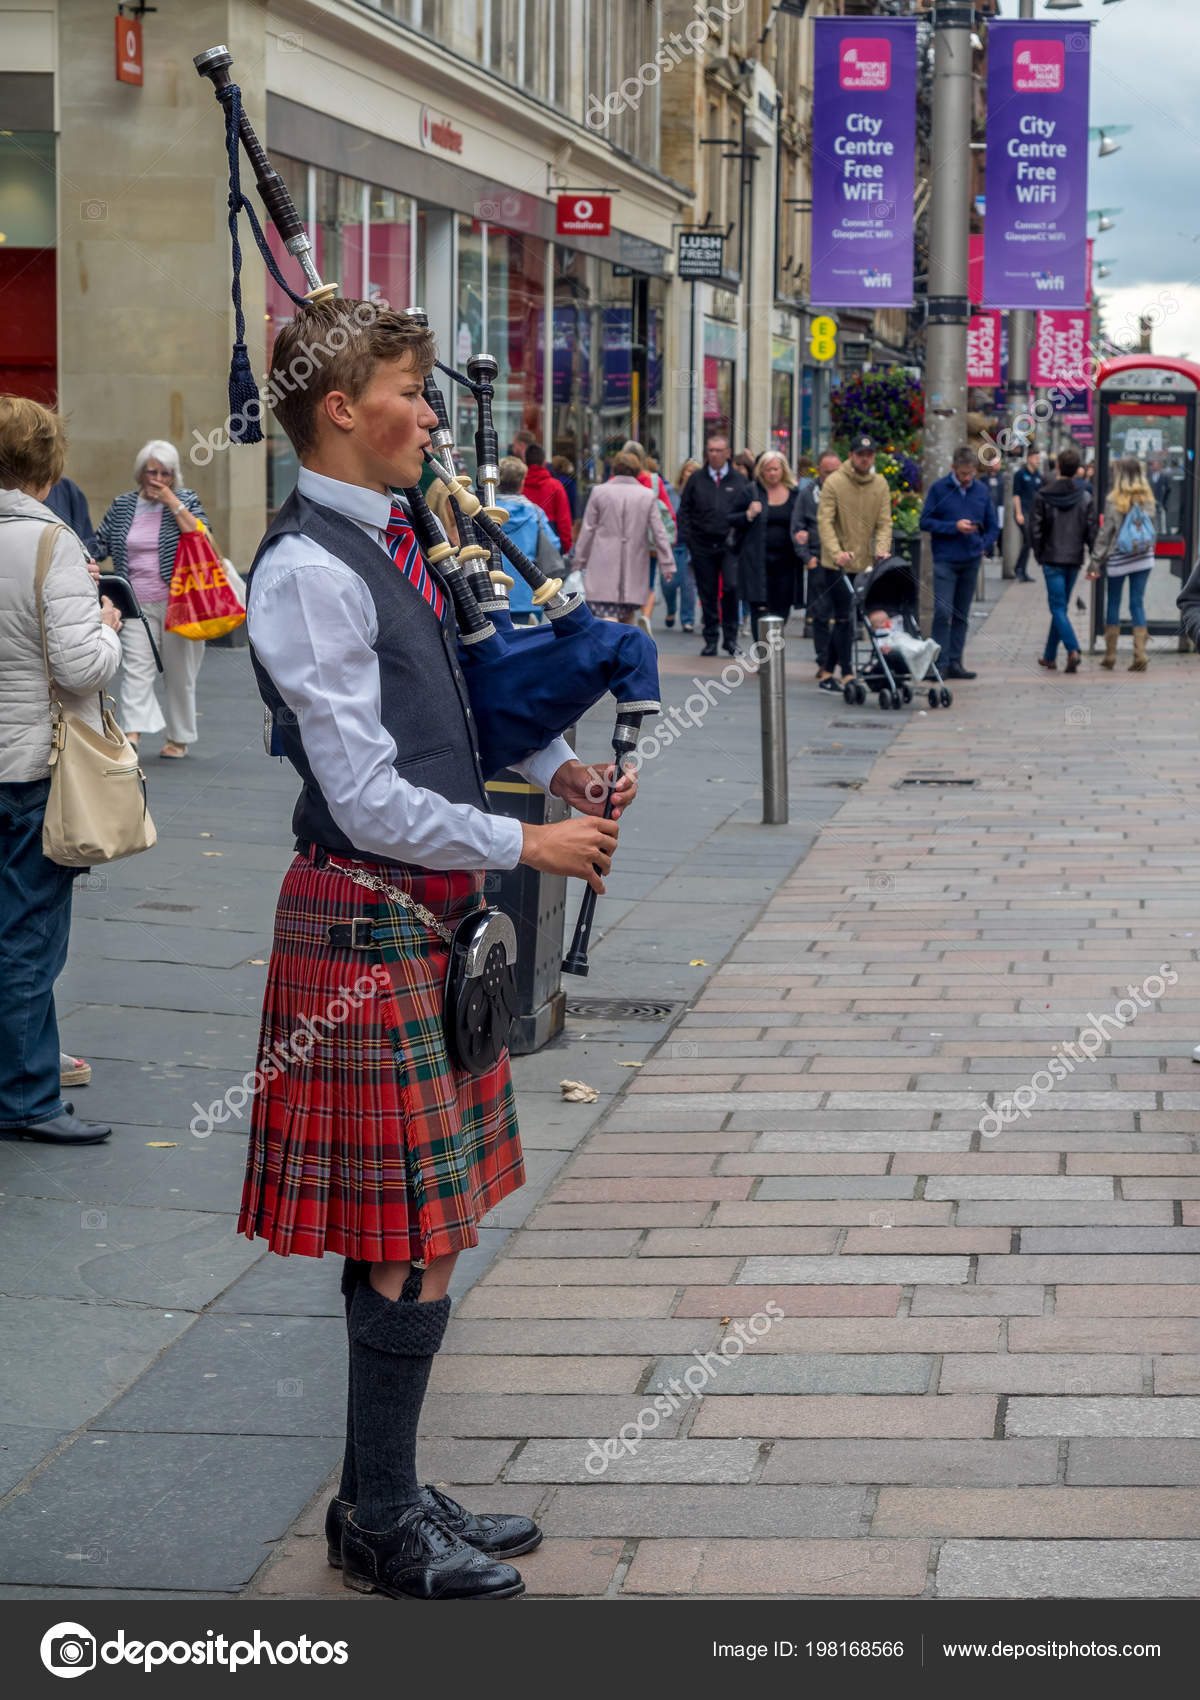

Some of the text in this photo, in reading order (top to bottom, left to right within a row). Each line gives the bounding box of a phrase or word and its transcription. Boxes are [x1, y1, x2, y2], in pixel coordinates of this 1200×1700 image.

[846, 112, 883, 136] City
[1019, 115, 1056, 138] City
[834, 136, 894, 155] Centre
[1007, 138, 1067, 158] Centre
[844, 159, 884, 178] Free
[1017, 161, 1056, 181] Free
[843, 182, 883, 201] WiFi
[1016, 183, 1056, 203] WiFi
[563, 220, 603, 231] vodafone
[841, 217, 873, 227] Connect
[1014, 220, 1046, 230] Connect
[680, 235, 721, 249] LUSH
[680, 249, 721, 259] FRESH
[863, 272, 892, 288] wifi
[1035, 275, 1064, 290] wifi
[979, 317, 994, 378] PEOPLE
[1037, 310, 1054, 377] ASGOW
[170, 567, 228, 597] SALE
